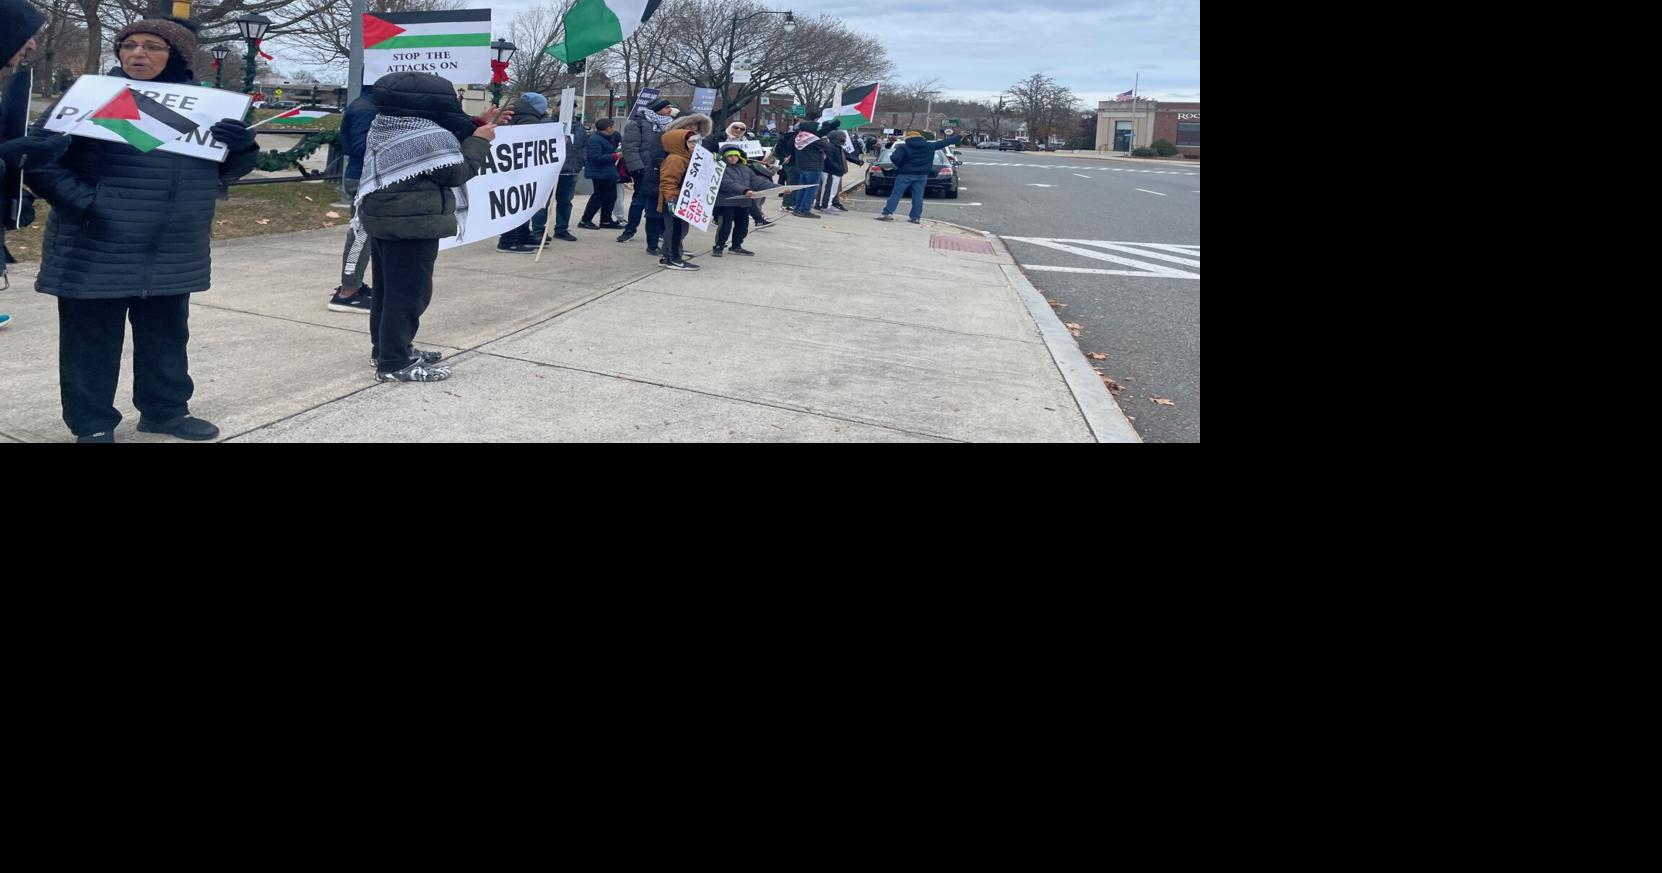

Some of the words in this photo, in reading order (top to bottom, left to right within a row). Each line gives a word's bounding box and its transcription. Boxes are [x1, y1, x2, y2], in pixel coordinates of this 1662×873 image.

[386, 62, 436, 73] ATTACKS
[440, 61, 458, 70] ON
[392, 52, 420, 61] STOP
[426, 51, 451, 60] THE
[137, 89, 198, 112] REE
[479, 138, 559, 176] ASEFIRE
[489, 181, 538, 220] NOW
[678, 181, 694, 217] KIDS
